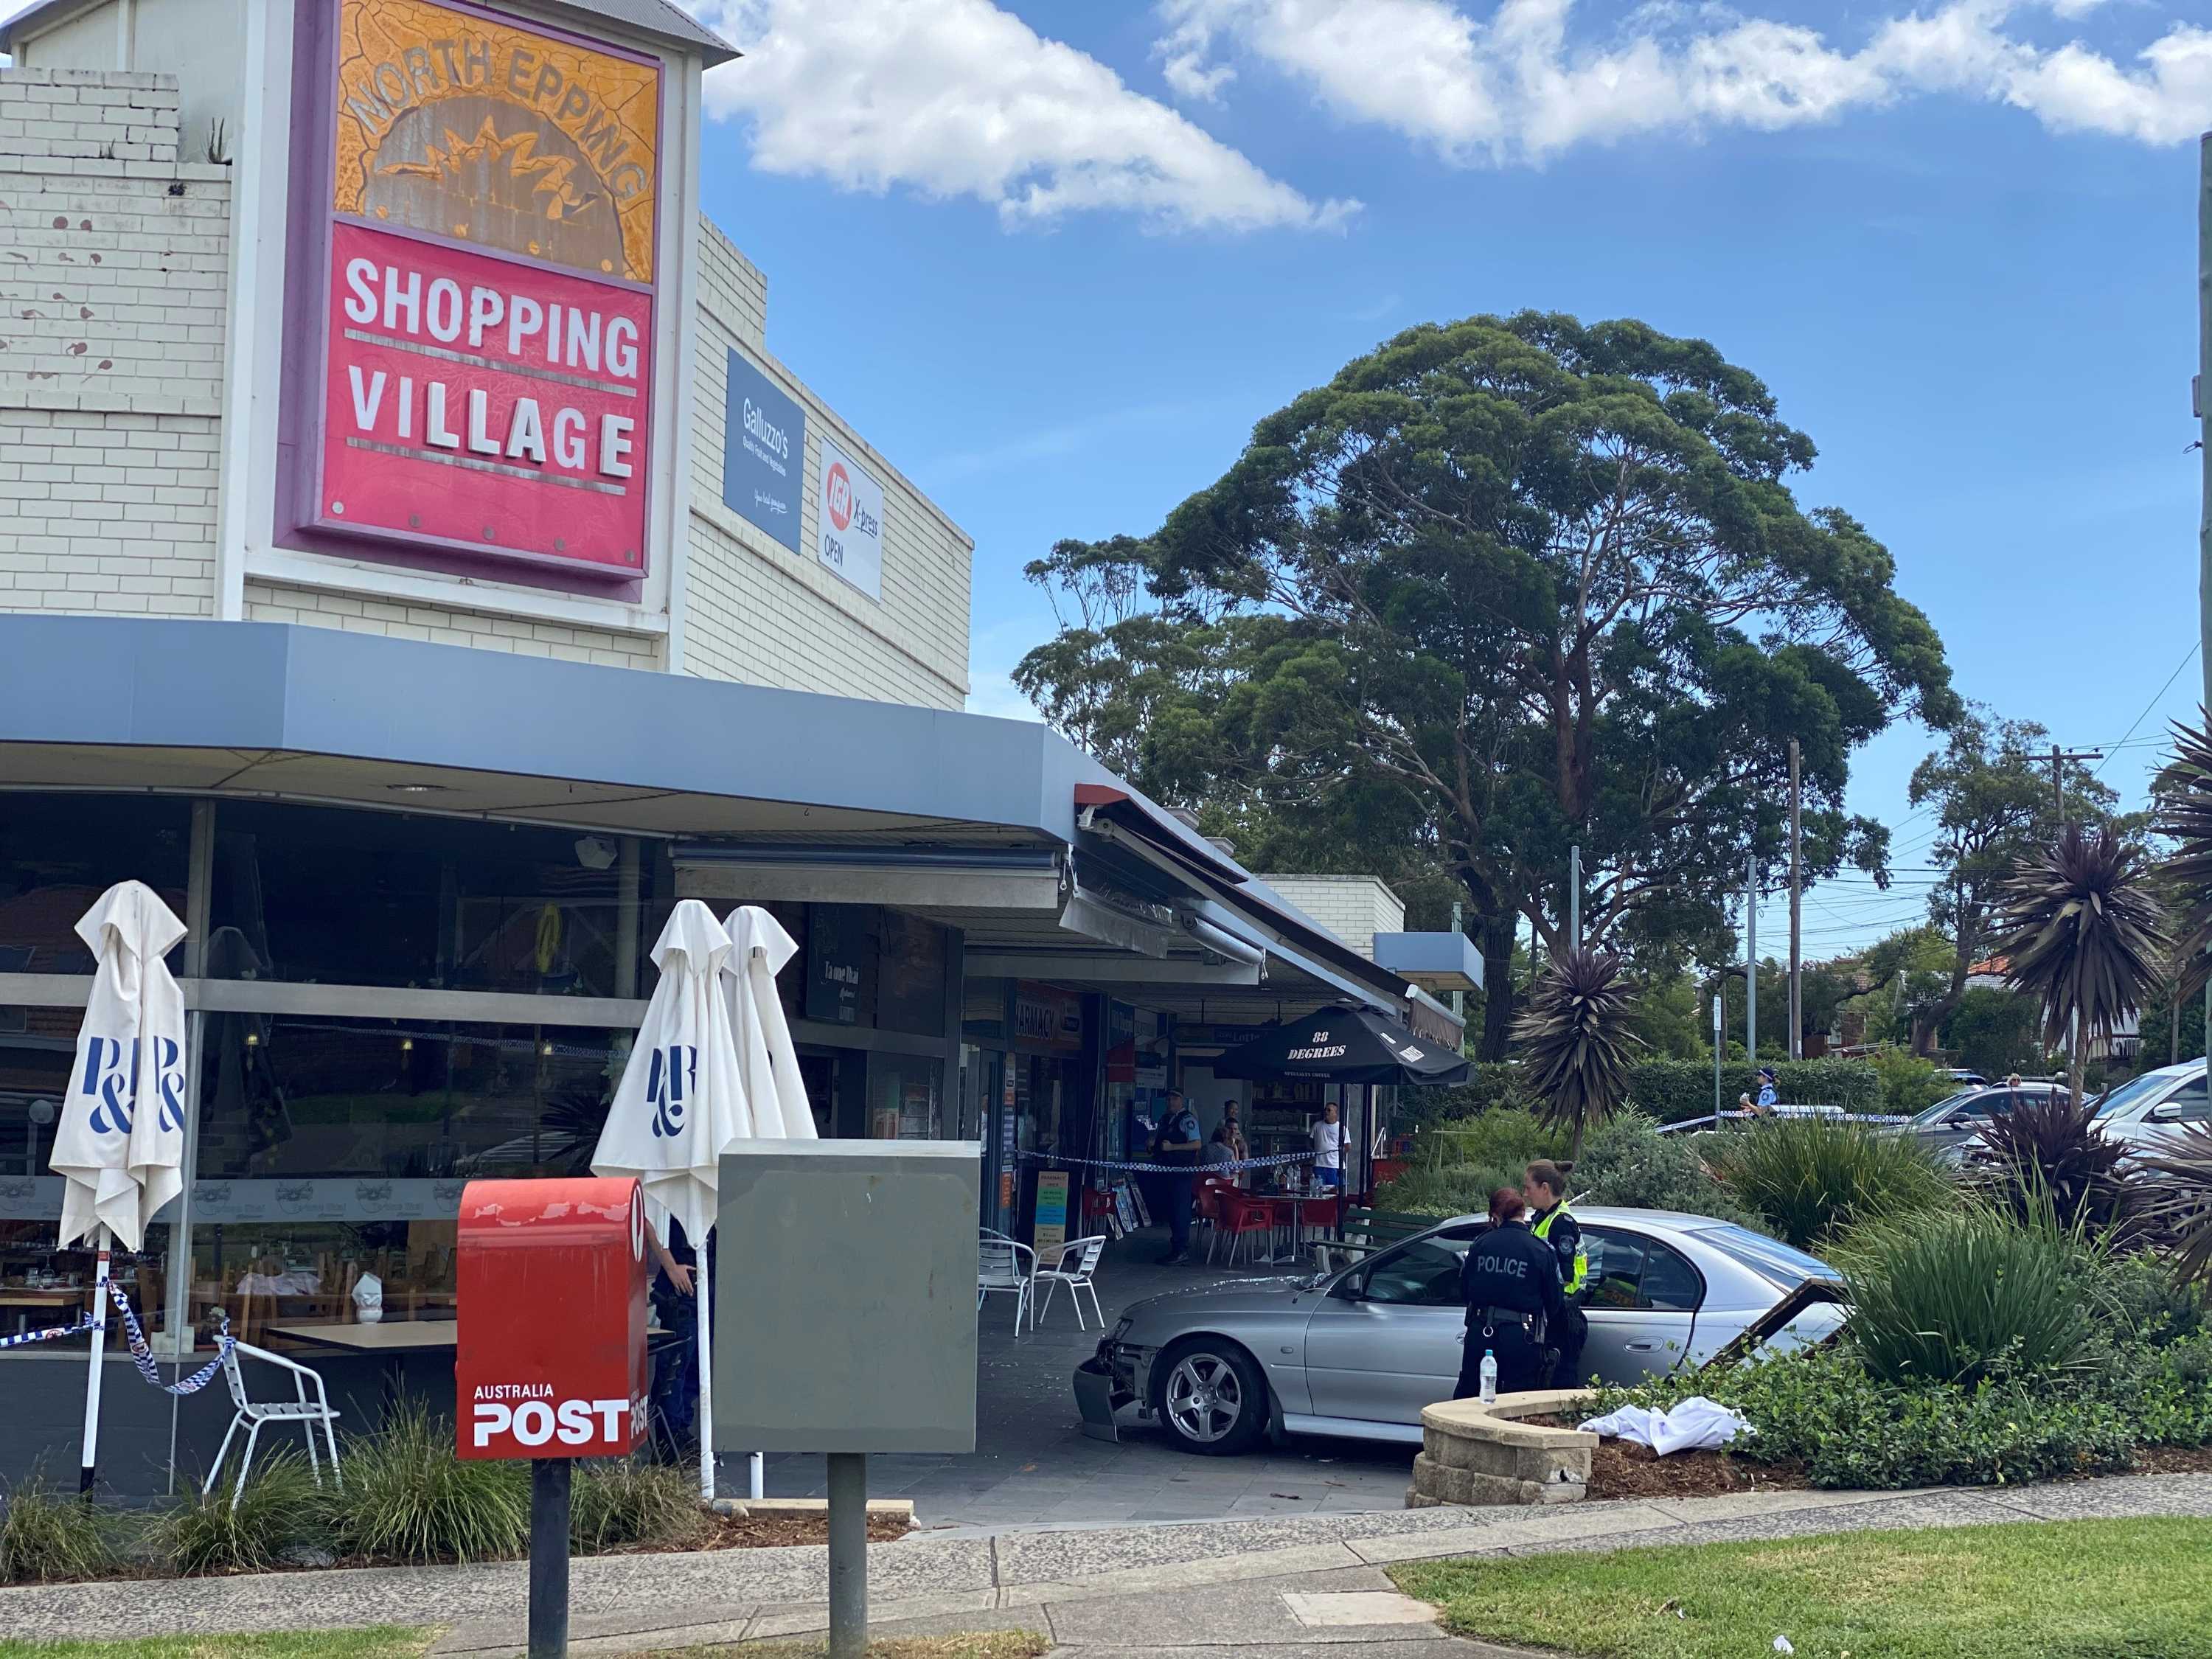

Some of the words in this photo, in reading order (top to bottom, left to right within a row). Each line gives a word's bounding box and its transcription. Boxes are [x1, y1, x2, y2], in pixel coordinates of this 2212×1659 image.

[346, 38, 493, 135] NORTH
[507, 47, 647, 200] EPPING
[344, 257, 639, 379] SHOPPING
[348, 365, 634, 478] VILLAGE
[743, 397, 788, 459] Galluzzo's
[829, 471, 850, 521] IGA
[824, 534, 844, 567] OPEN
[1287, 1044, 1347, 1060] DEGREES
[1312, 1032, 1329, 1043] 88
[1477, 1255, 1528, 1279] POLICE
[474, 1383, 554, 1399] AUSTRALIA
[474, 1399, 630, 1447] POST
[630, 1394, 649, 1440] POST
